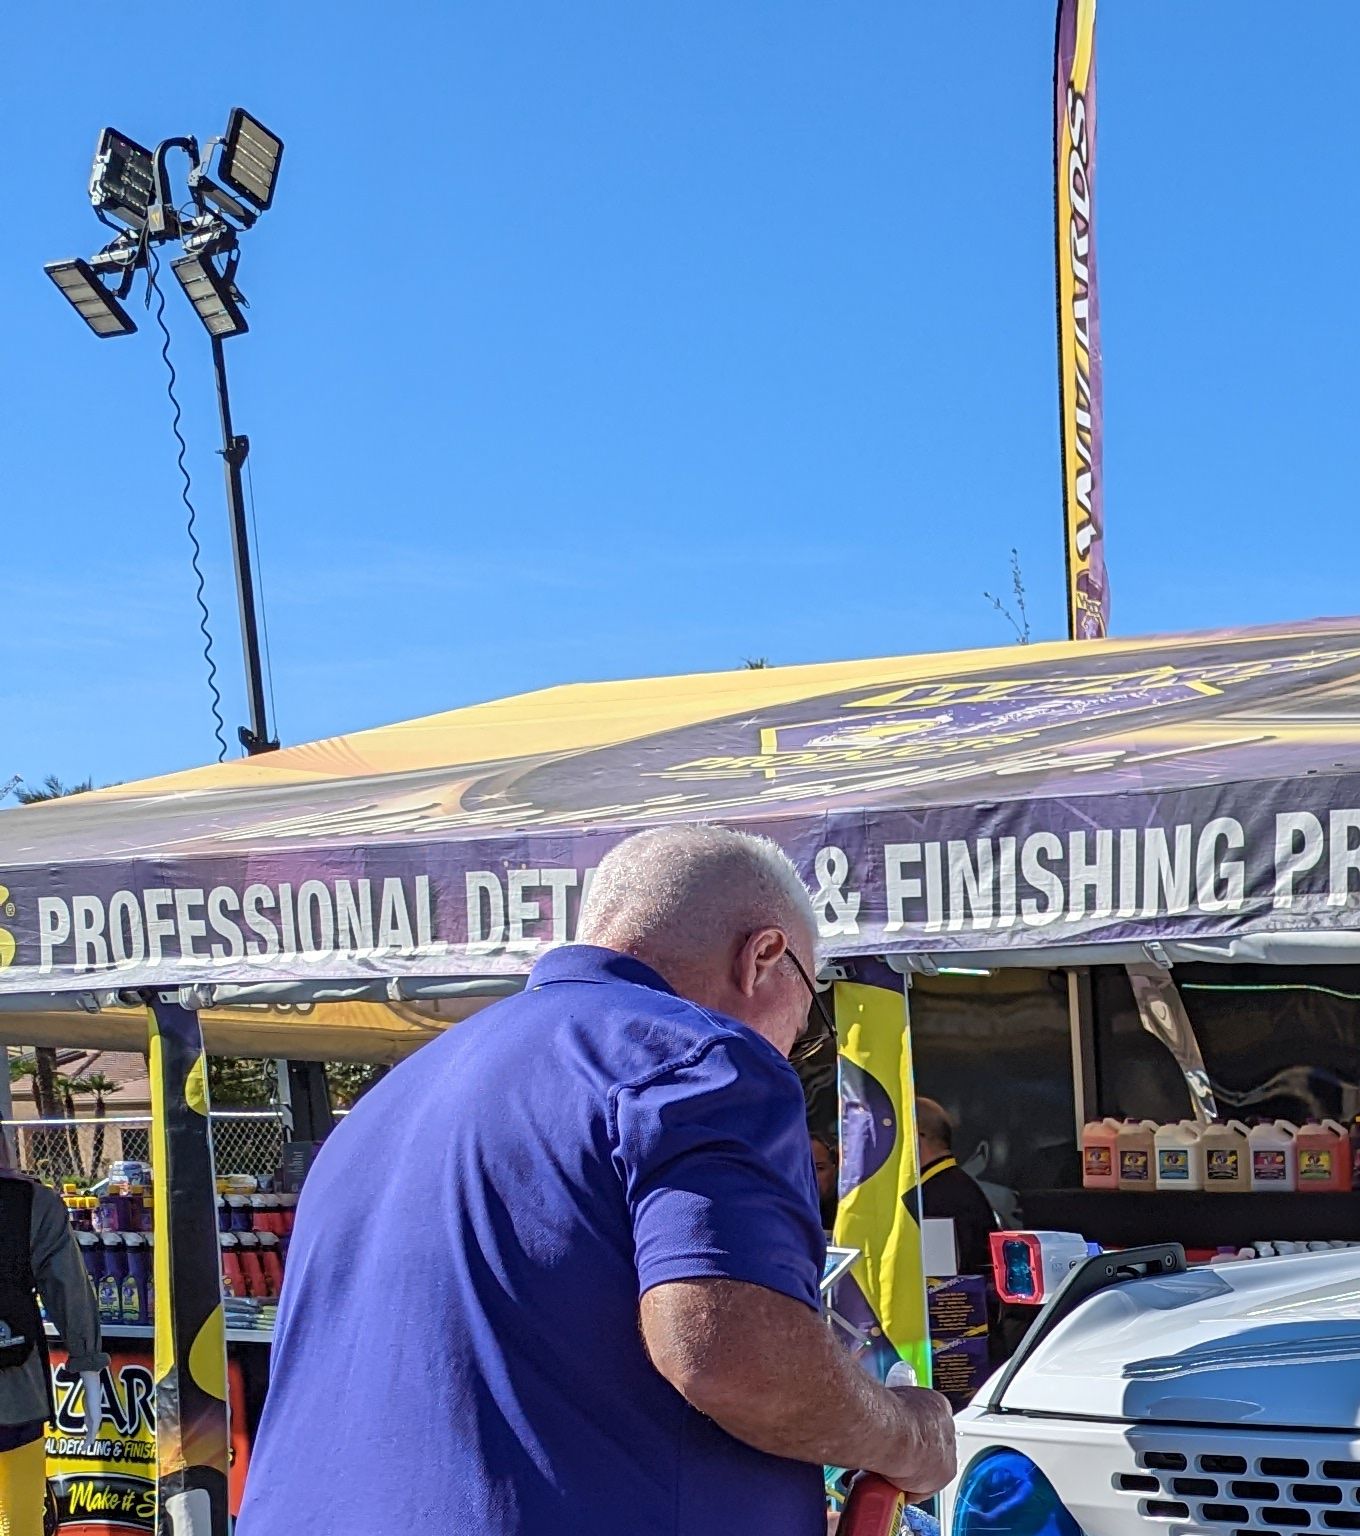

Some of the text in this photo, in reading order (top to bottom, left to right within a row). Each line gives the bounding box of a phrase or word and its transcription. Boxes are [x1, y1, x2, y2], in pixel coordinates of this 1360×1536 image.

[664, 731, 1040, 772] PRODUCTS
[37, 874, 448, 975] PROFESSIONAL
[466, 866, 599, 956] DET
[812, 846, 861, 937] &
[882, 816, 1246, 934] FINISHING
[59, 1438, 111, 1457] DETALING
[68, 1481, 118, 1514] Make
[121, 1485, 134, 1508] it
